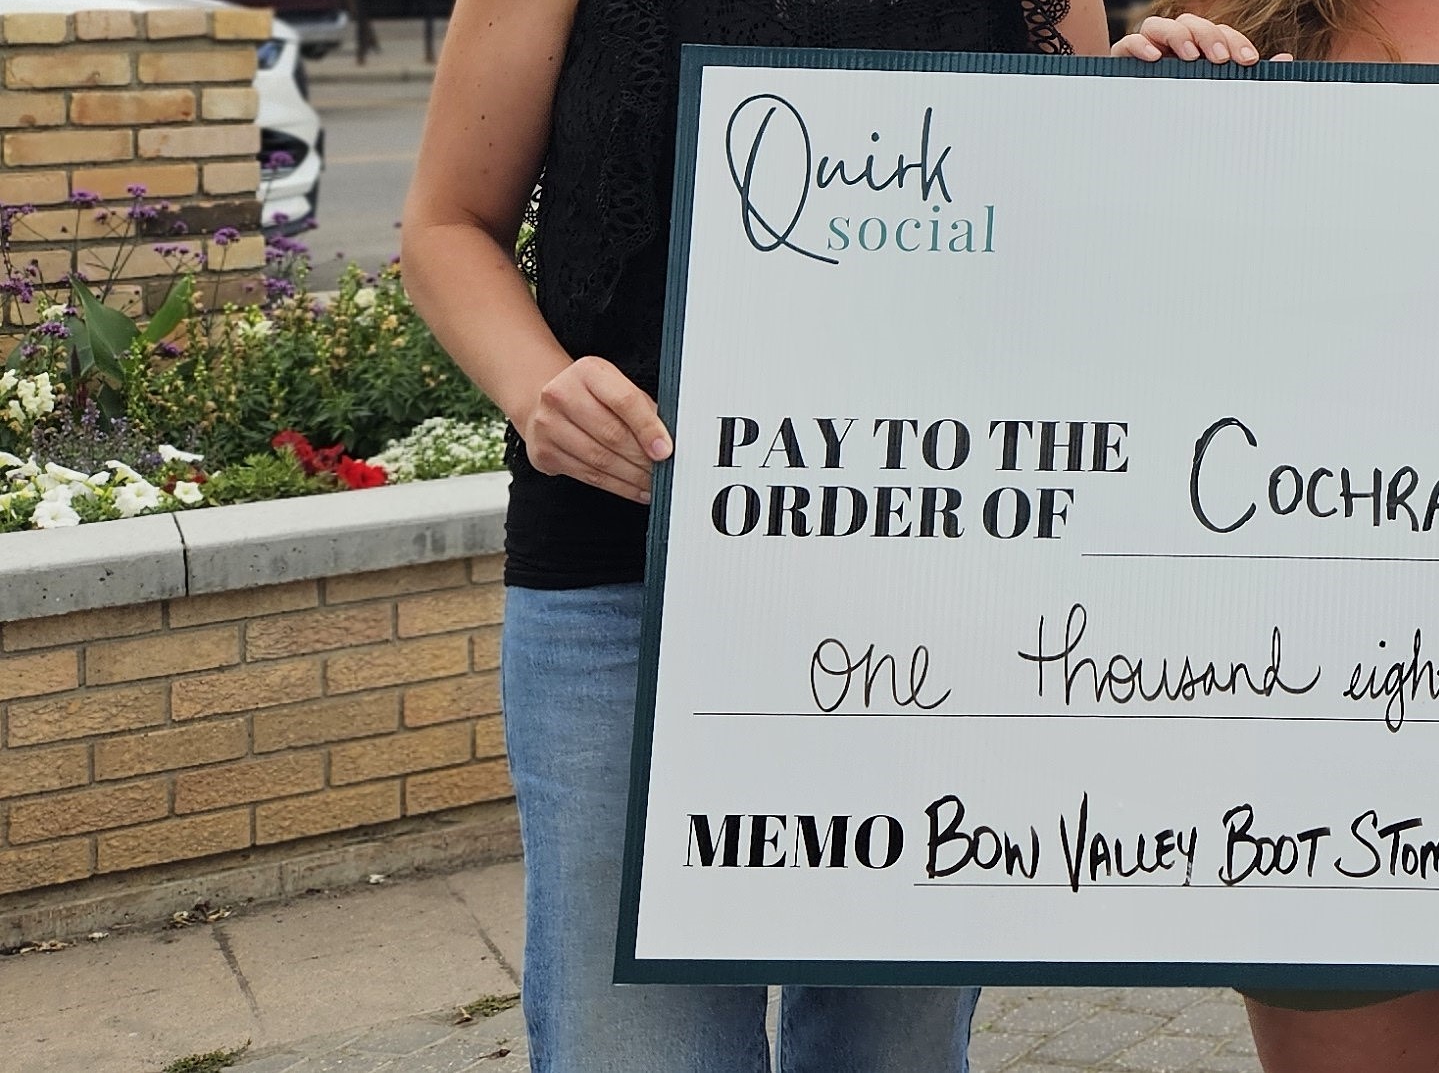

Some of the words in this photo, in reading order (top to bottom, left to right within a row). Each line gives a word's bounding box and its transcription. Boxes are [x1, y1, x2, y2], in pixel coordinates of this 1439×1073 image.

[726, 94, 952, 264] Quirk
[827, 205, 996, 253] social
[713, 416, 859, 470] PAY
[873, 418, 971, 471] TO
[989, 420, 1129, 473] THE
[711, 484, 965, 539] ORDER
[983, 487, 1075, 539] OF
[1018, 603, 1321, 705] thousand
[683, 814, 904, 869] MEMO
[1060, 791, 1197, 893] VALLEY
[1219, 803, 1331, 887] BOOT
